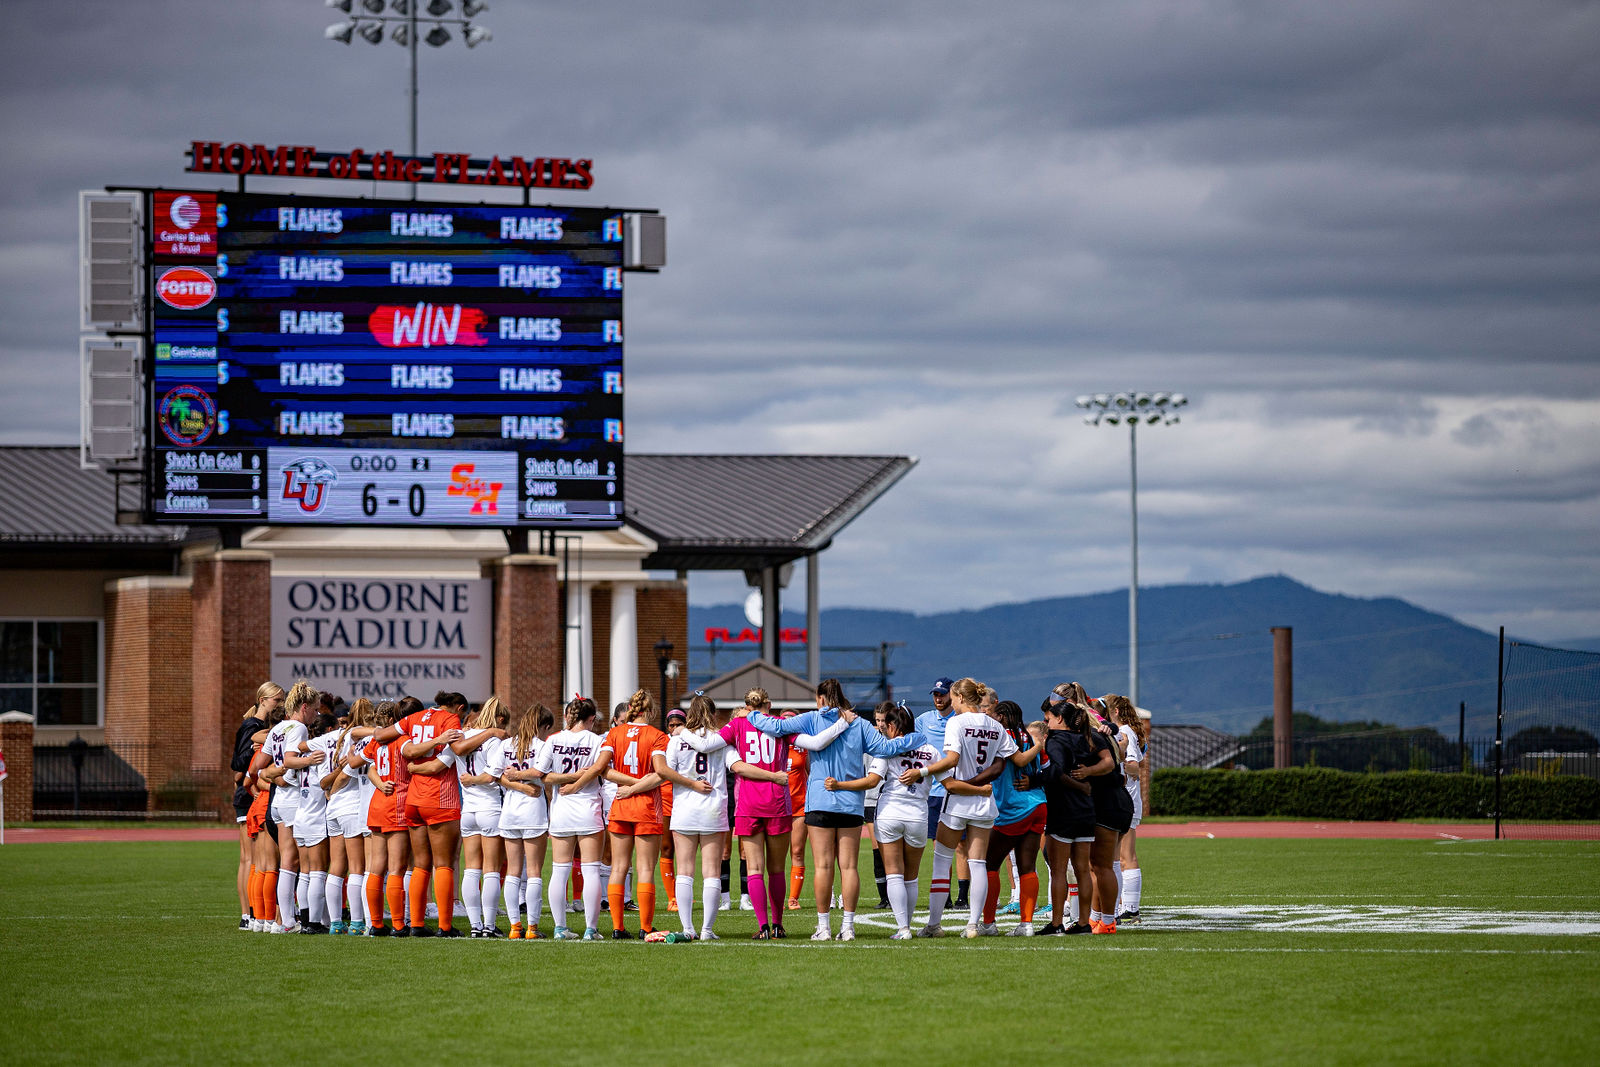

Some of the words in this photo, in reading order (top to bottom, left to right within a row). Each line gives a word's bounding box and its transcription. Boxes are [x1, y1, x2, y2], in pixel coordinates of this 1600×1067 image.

[191, 141, 317, 177] HOME
[329, 149, 364, 179] of
[372, 150, 423, 182] the
[433, 153, 594, 189] FLAMES
[278, 207, 343, 233] FLAMES
[391, 212, 454, 238] FLAMES
[500, 217, 563, 241] FLAMES
[279, 256, 344, 282] FLAMES
[390, 261, 453, 286] FLAMES
[498, 265, 562, 289] FLAMES
[160, 280, 212, 295] FOSTER
[280, 310, 344, 335] FLAMES
[393, 301, 461, 348] WIN
[499, 316, 562, 342] FLAMES
[280, 362, 344, 387] FLAMES
[391, 365, 453, 389] FLAMES
[499, 368, 562, 392] FLAMES
[280, 411, 344, 436] FLAMES
[392, 413, 455, 438] FLAMES
[501, 416, 565, 440] FLAMES
[166, 451, 197, 470] Shots
[199, 451, 215, 470] On
[216, 451, 242, 470] Goal
[350, 456, 396, 472] 0:00
[525, 457, 555, 475] Shots
[556, 458, 572, 475] On
[573, 458, 598, 475] Goal
[165, 472, 199, 490] Saves
[525, 478, 557, 496] Saves
[166, 491, 209, 511] Corners
[525, 497, 567, 514] Corners
[288, 580, 469, 613] OSBORNE
[287, 617, 467, 649] STADIUM
[347, 680, 408, 697] TRACK
[965, 728, 999, 741] FLAMES
[553, 743, 592, 756] FLAMES
[623, 740, 639, 775] 4
[745, 731, 775, 764] 30
[976, 741, 988, 765] 5
[561, 757, 580, 774] 21
[696, 751, 708, 774] 8
